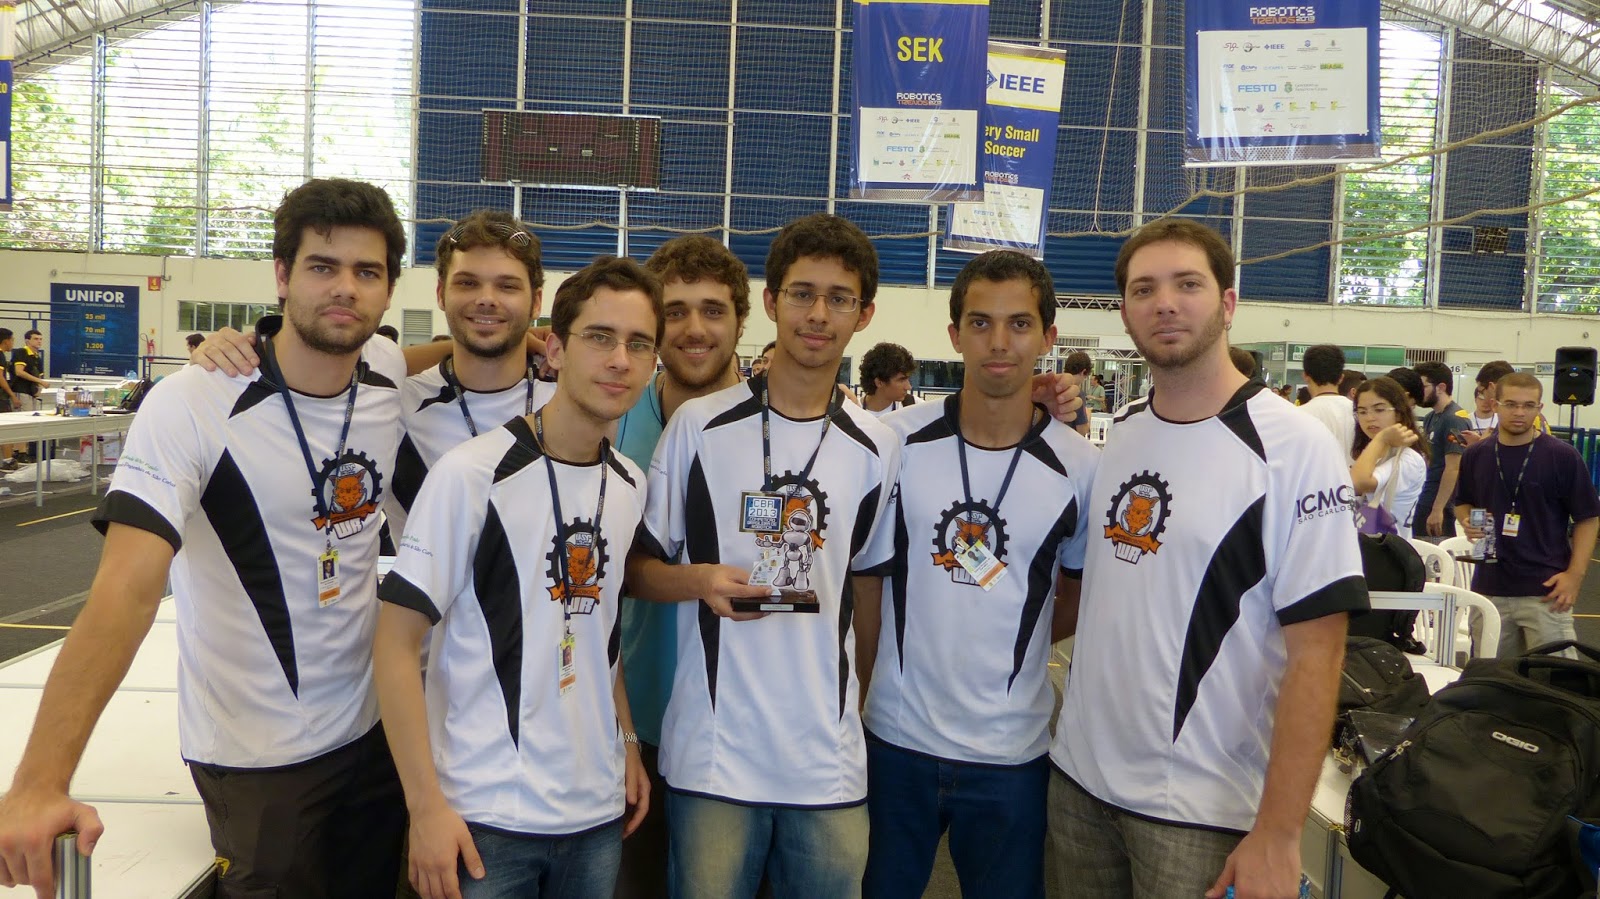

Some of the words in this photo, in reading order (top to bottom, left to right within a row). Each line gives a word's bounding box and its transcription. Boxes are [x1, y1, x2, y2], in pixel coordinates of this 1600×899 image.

[1250, 6, 1315, 17] ROBOTICS
[1251, 16, 1296, 24] TRENDS
[897, 36, 943, 62] SEK
[999, 73, 1046, 94] IEEE
[1238, 84, 1277, 93] FESTO
[896, 92, 942, 100] ROBOTICS
[985, 125, 1002, 141] ery
[1005, 125, 1039, 142] Small
[984, 140, 1026, 158] Soccer
[65, 289, 125, 303] UNIFOR
[753, 498, 774, 508] CBR
[1296, 484, 1351, 518] ICMC
[749, 508, 777, 518] 2013
[1318, 504, 1352, 518] CARLOS
[1492, 731, 1539, 753] OGIO
